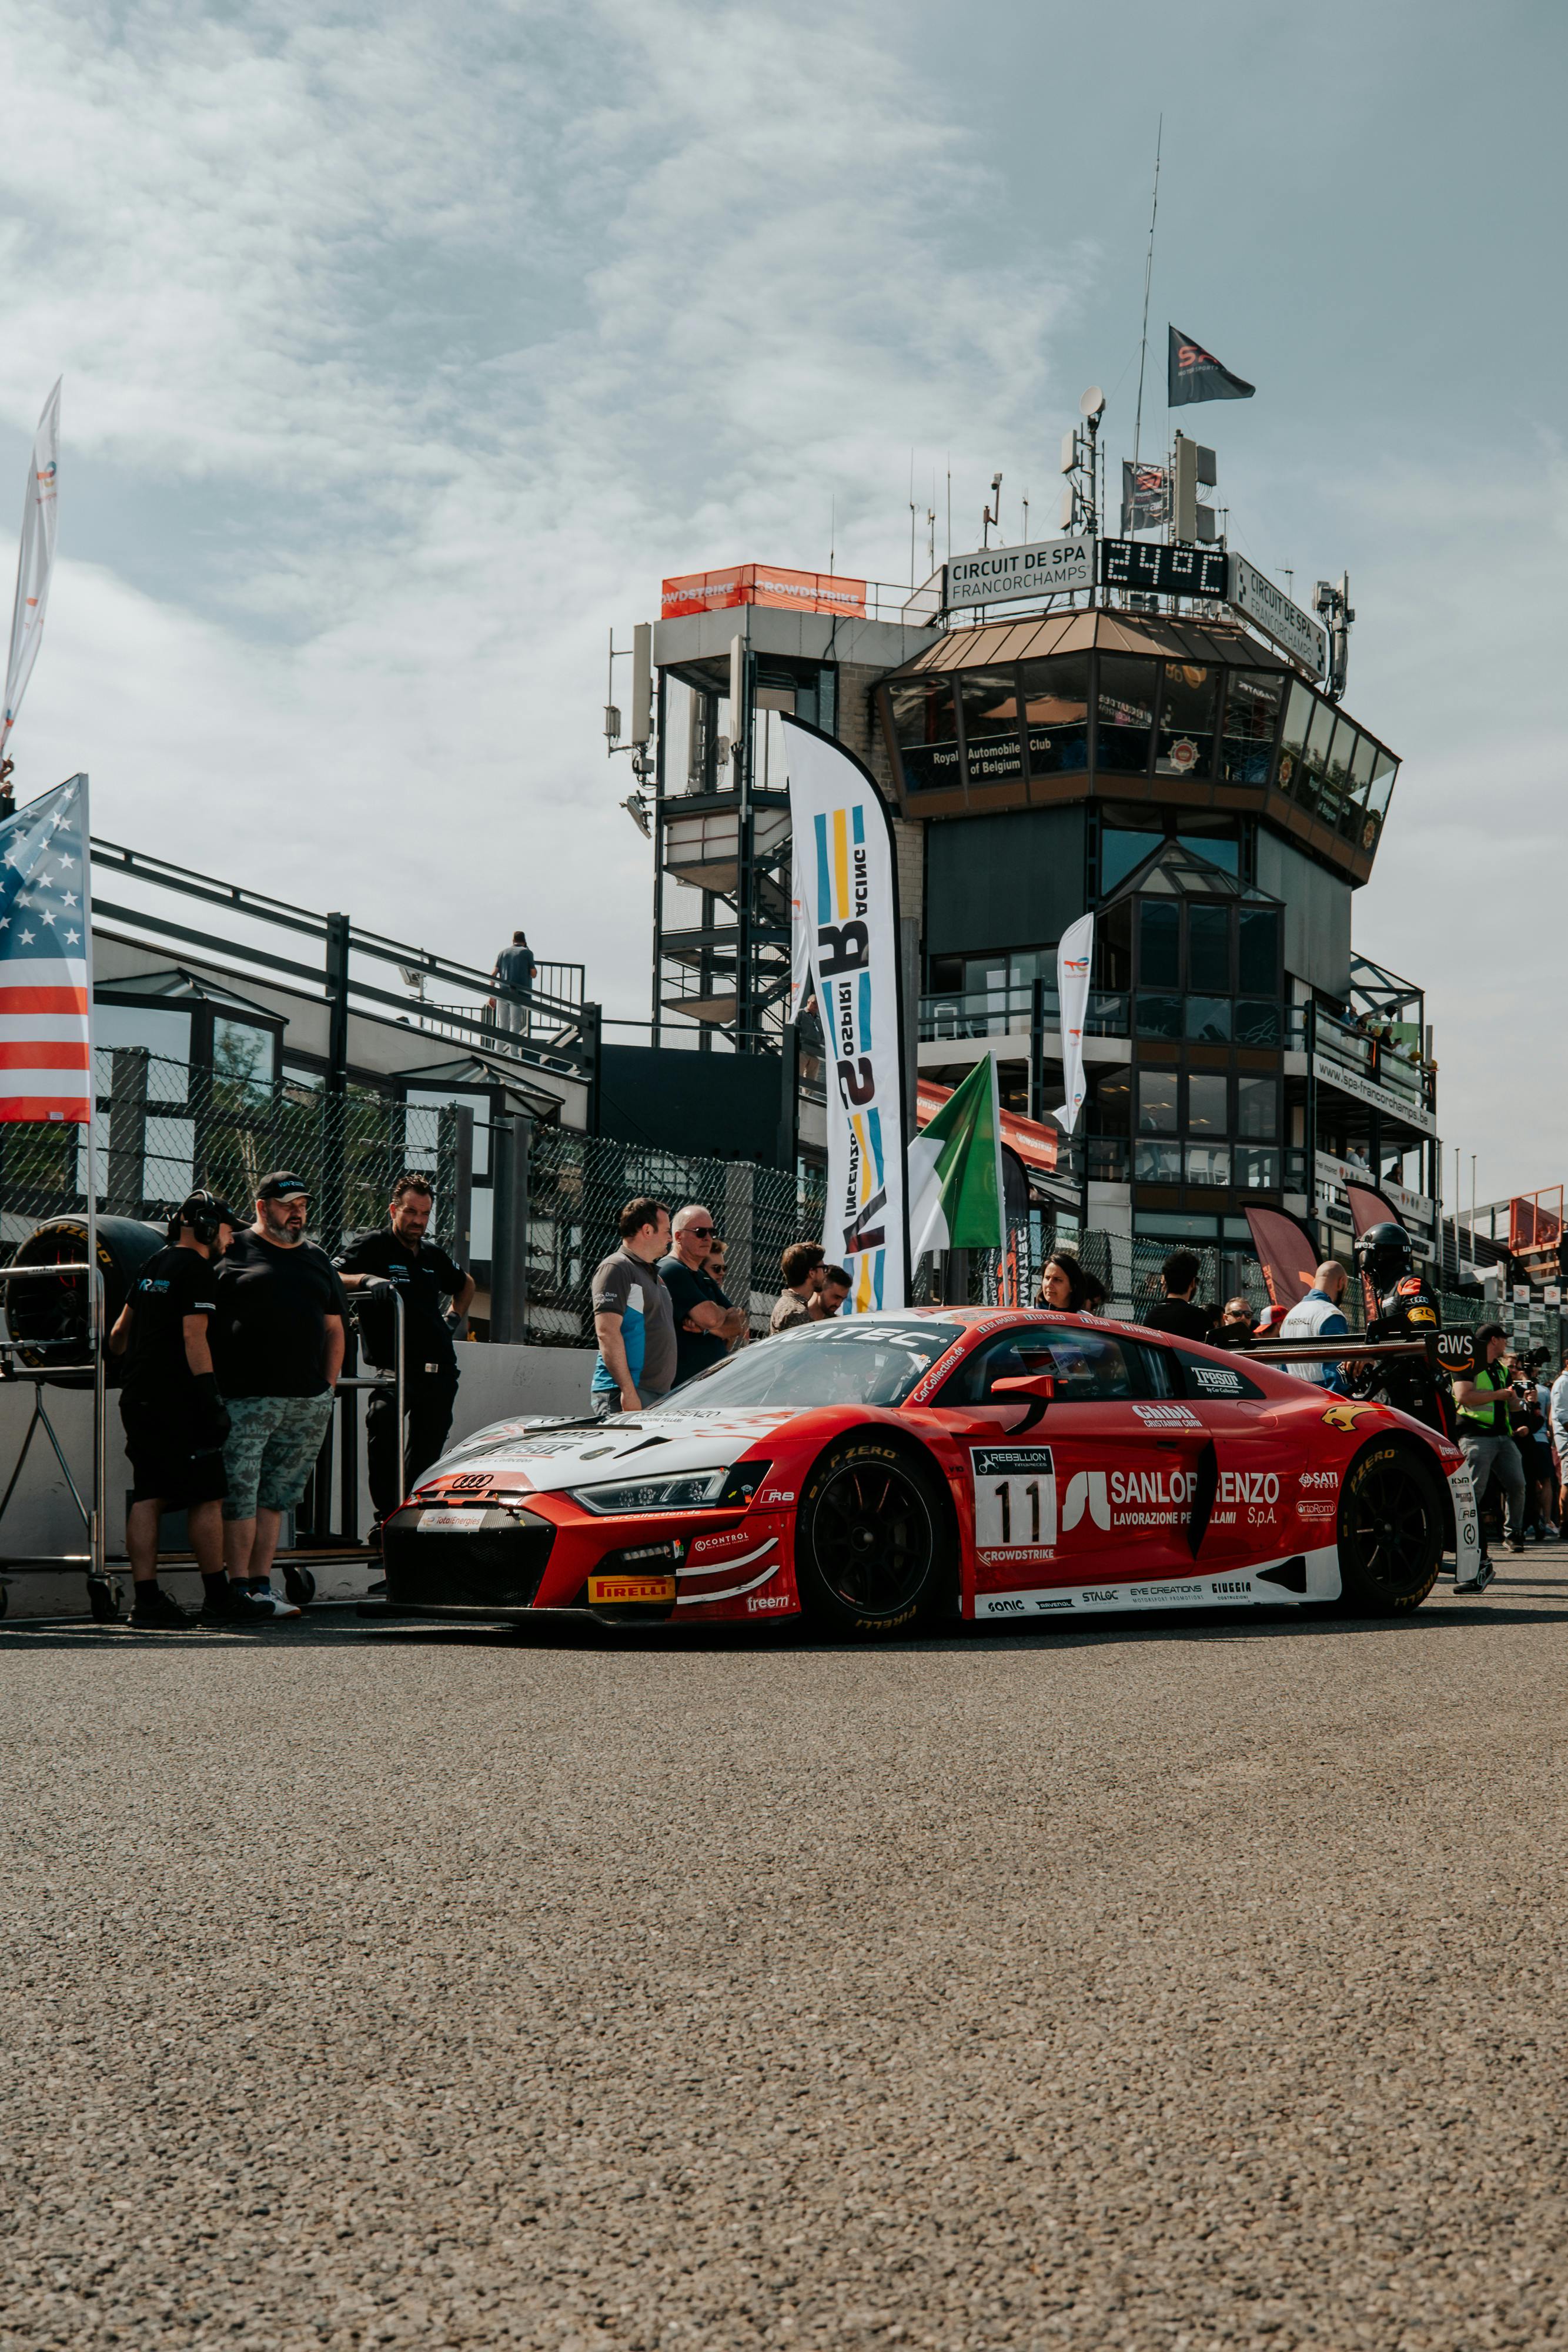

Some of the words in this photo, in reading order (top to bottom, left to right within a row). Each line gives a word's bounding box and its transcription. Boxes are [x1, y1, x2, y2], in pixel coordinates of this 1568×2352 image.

[953, 556, 1019, 581] CIRCUIT
[1025, 553, 1047, 570] DE
[1052, 545, 1086, 564] SPA
[952, 565, 1087, 599] FRANCORCHAMPS
[755, 580, 860, 604] CROWDSTRIKE
[1251, 573, 1282, 615] CIRCUIT
[1285, 602, 1295, 626] DE
[1296, 614, 1312, 642] SPA
[1251, 597, 1313, 663] FRANCORCHAMPS
[933, 751, 959, 765] Royal
[968, 742, 1021, 760] Automobile
[1029, 737, 1051, 751] Club
[970, 764, 980, 774] of
[982, 759, 1021, 774] Belgium
[1319, 1063, 1429, 1126] www.spa-francorchamps.be
[995, 1315, 1017, 1327] AMATO
[1092, 1319, 1110, 1327] JEAN
[1134, 1326, 1164, 1339] PATRESE
[1437, 1334, 1473, 1355] aws
[912, 1345, 965, 1403] CarCollection.de
[1191, 1367, 1239, 1386] Tresor
[1132, 1405, 1196, 1419] Ghibli
[1313, 1472, 1339, 1484] SATI
[768, 1492, 794, 1501] R8
[603, 1509, 702, 1522] CarCollection.de
[994, 1481, 1041, 1543] 11
[1297, 1504, 1335, 1514] OrtoRomi
[1462, 1509, 1476, 1519] R8
[436, 1516, 480, 1526] TotalEnergies
[1114, 1512, 1178, 1525] LAVORAZIONE
[1247, 1506, 1277, 1528] S.p.A.
[706, 1532, 748, 1546] CONTROL
[983, 1548, 1054, 1562] CROWDSTRIKE
[596, 1579, 667, 1598] PIRELLI
[1130, 1587, 1149, 1596] EYE
[1150, 1585, 1202, 1594] CREATIONS
[1212, 1582, 1252, 1593] GIUGGIA
[747, 1595, 789, 1612] freem
[1082, 1590, 1119, 1603] STALOC
[988, 1599, 1025, 1612] SONIC
